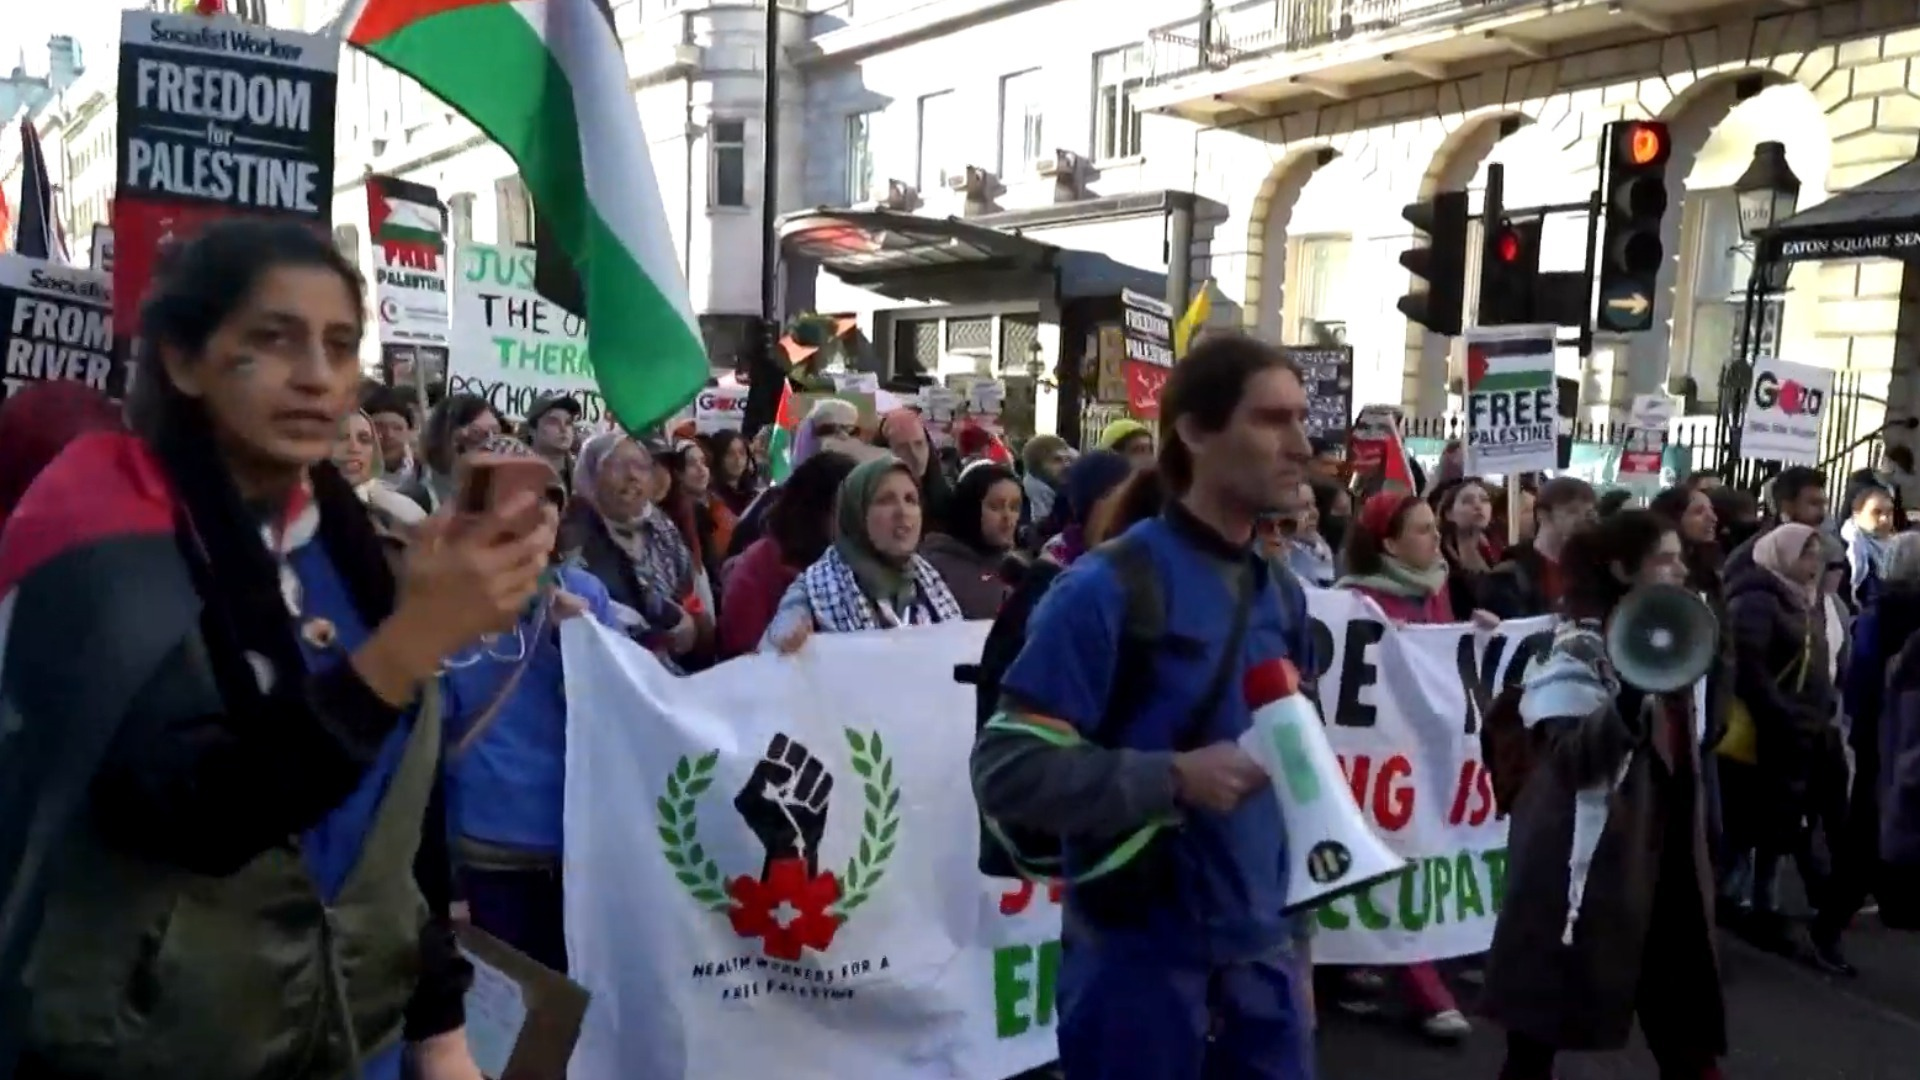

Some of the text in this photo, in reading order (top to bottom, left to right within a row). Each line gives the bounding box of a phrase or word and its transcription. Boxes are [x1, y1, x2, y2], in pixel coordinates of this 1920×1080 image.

[136, 57, 312, 132] FREEDOM
[206, 119, 234, 147] for
[126, 136, 320, 213] PALESTINE
[1781, 239, 1830, 255] EATON
[1832, 234, 1892, 253] SQUARE
[465, 248, 537, 290] JUS
[11, 295, 114, 352] FROM
[478, 292, 550, 335] THE
[5, 337, 112, 391] RIVER
[491, 335, 597, 379] THERA
[1468, 388, 1554, 428] FREE
[1468, 423, 1554, 446] PALESTINE
[1336, 754, 1416, 832] NG
[692, 954, 890, 984] HEALTH WORKERS FOR A
